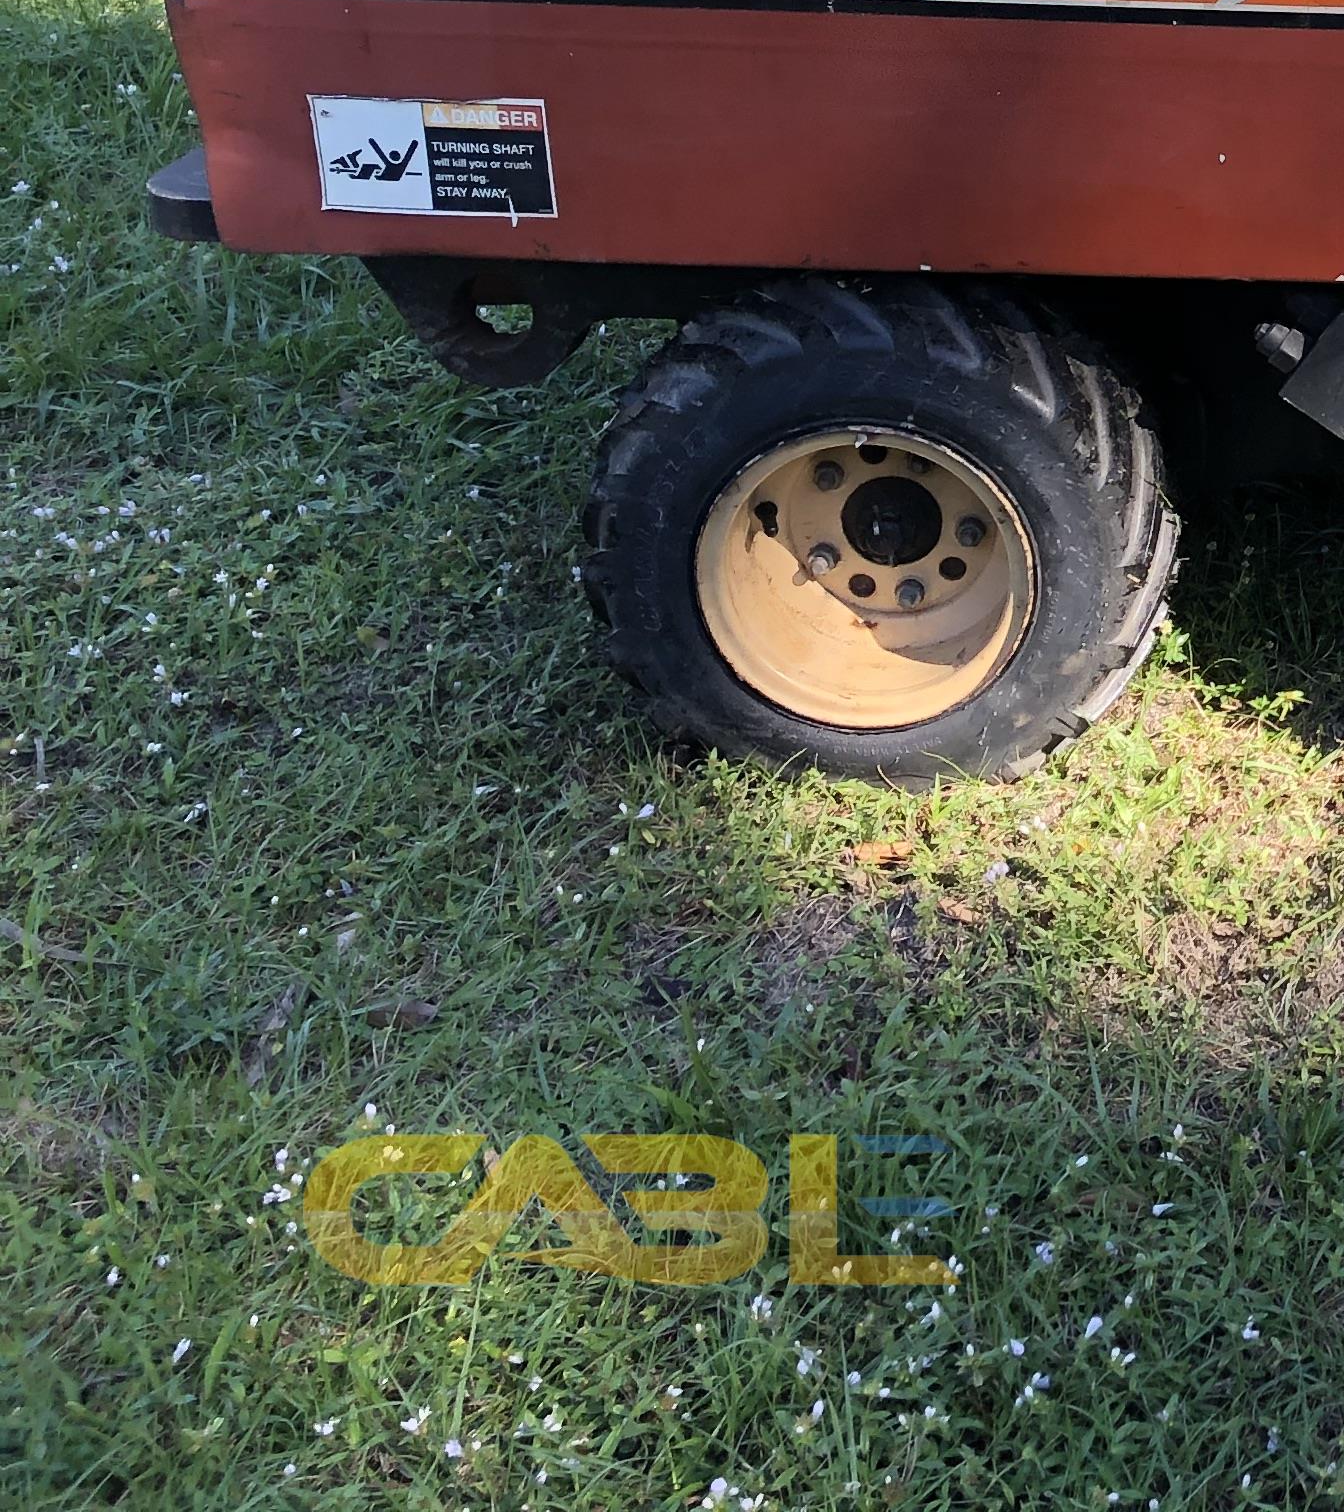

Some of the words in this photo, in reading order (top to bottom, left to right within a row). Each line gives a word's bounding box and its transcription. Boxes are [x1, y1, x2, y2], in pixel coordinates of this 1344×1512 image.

[450, 108, 538, 127] DANGER
[431, 141, 490, 154] TURNING
[492, 143, 534, 156] SHAFT
[433, 157, 450, 167] will
[452, 158, 467, 168] kill
[468, 160, 488, 170] you
[489, 160, 501, 169] or
[503, 160, 533, 170] crush
[435, 173, 455, 182] arm
[456, 173, 469, 182] or
[470, 173, 490, 185] leg.
[436, 186, 468, 197] STAY
